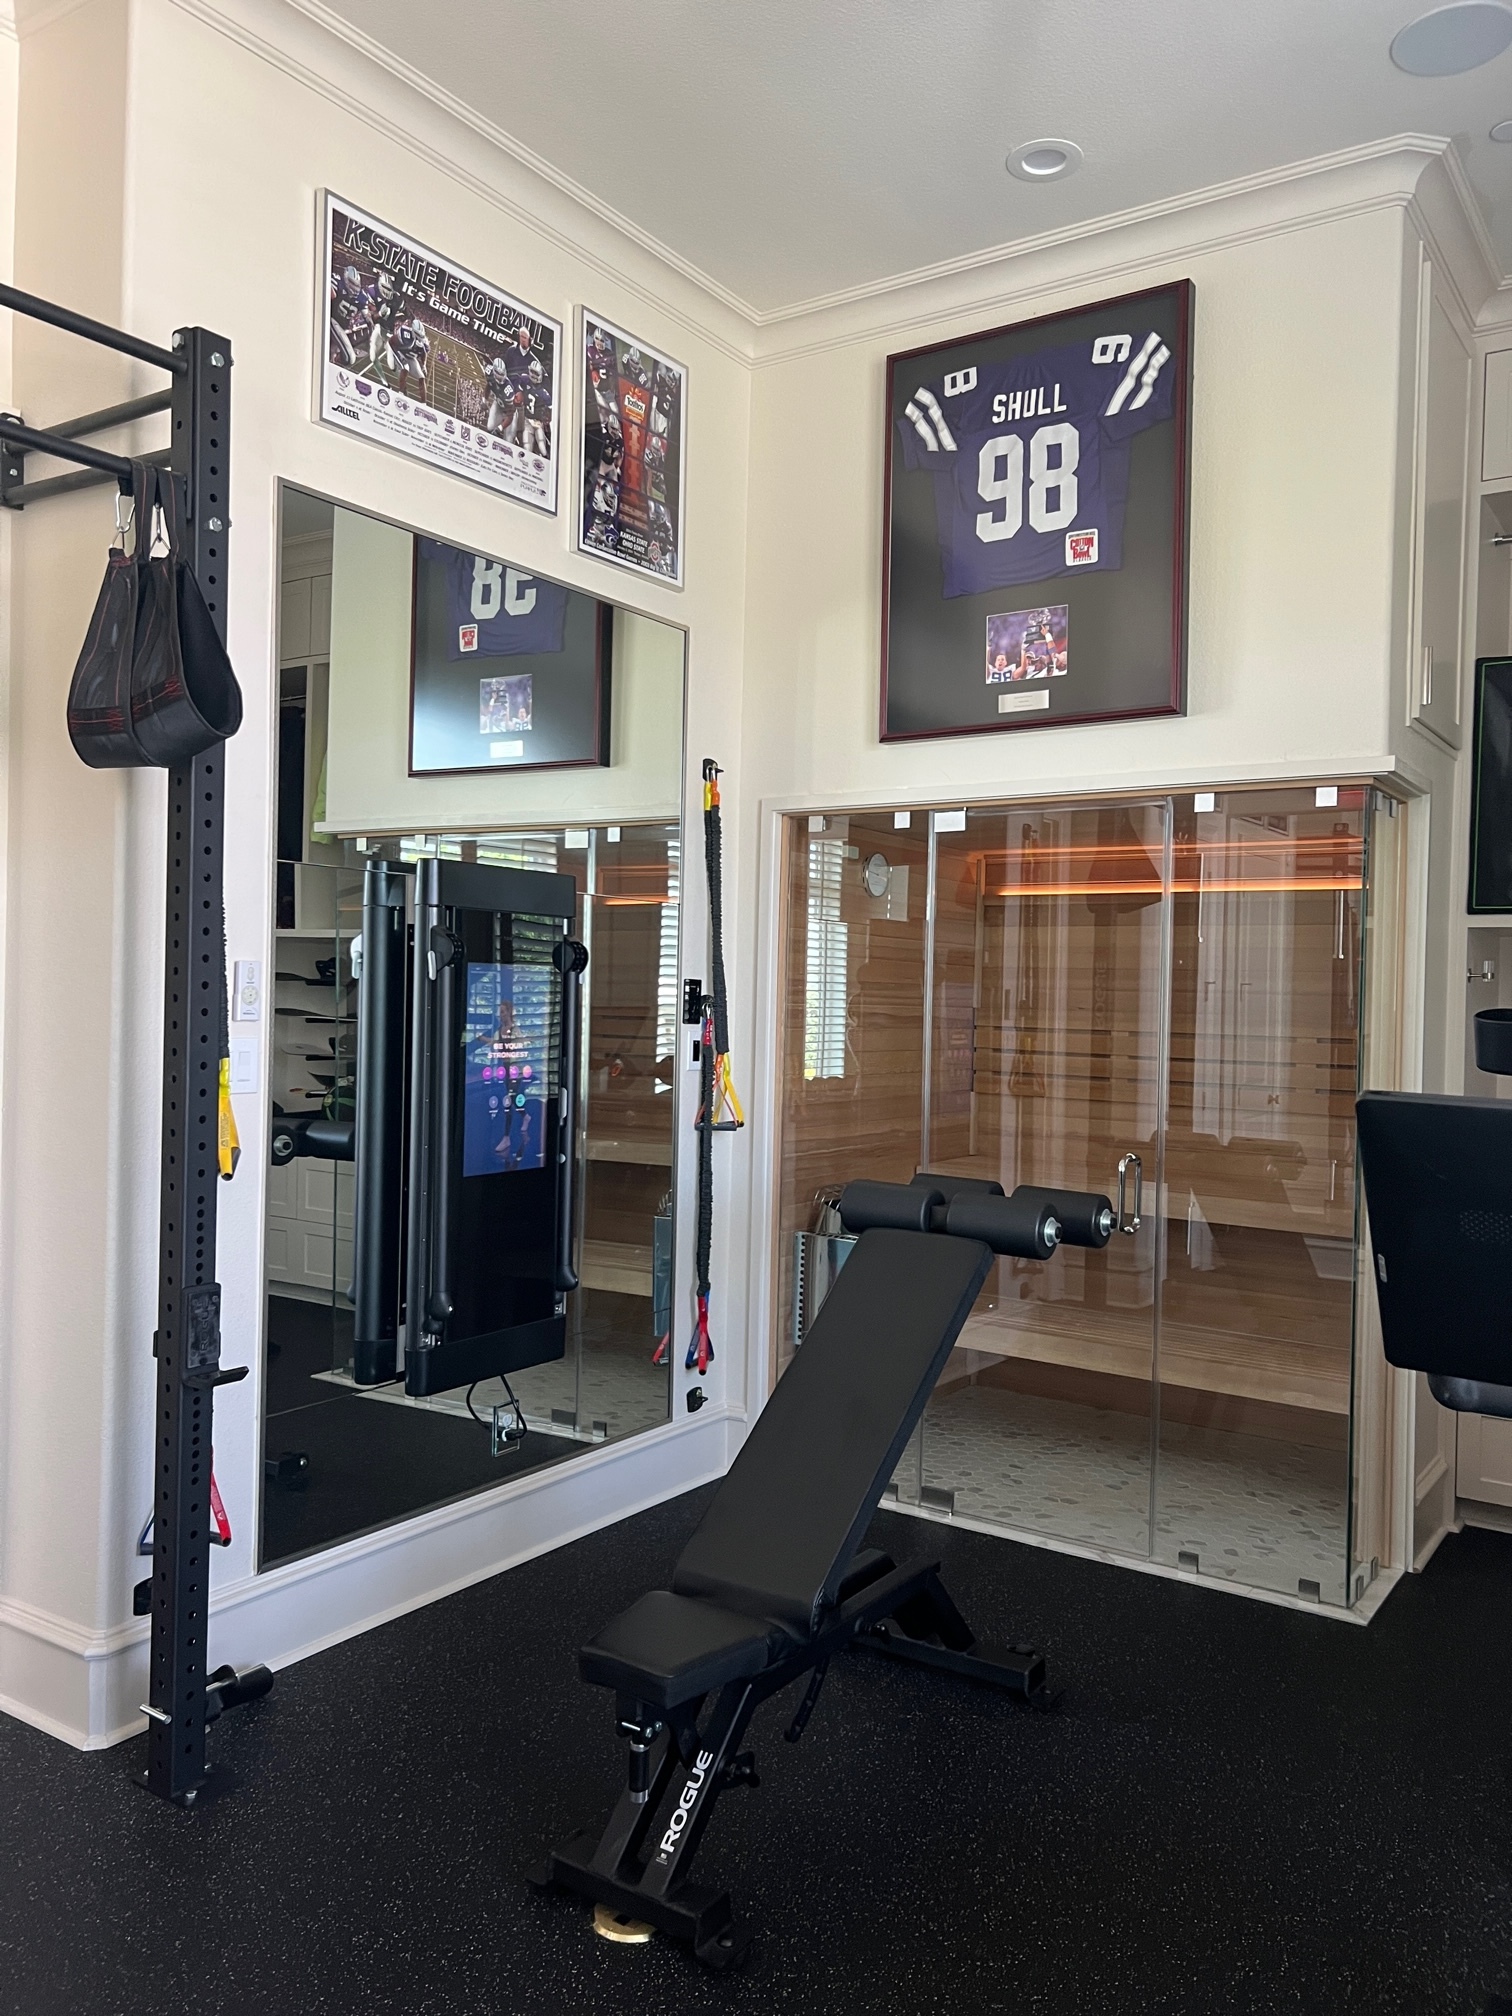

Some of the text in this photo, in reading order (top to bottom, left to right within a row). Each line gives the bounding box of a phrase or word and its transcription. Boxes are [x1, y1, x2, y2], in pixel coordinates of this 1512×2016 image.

[344, 216, 439, 292] K-STATE
[401, 281, 505, 344] It's Game Time
[332, 405, 360, 421] ALLTEL
[992, 383, 1067, 424] SHULL
[976, 422, 1080, 543] 98
[620, 530, 636, 542] KANSAS
[487, 1051, 529, 1059] STRONGEST
[493, 1042, 524, 1050] BE YOUR
[660, 1749, 714, 1853] ROGUE
